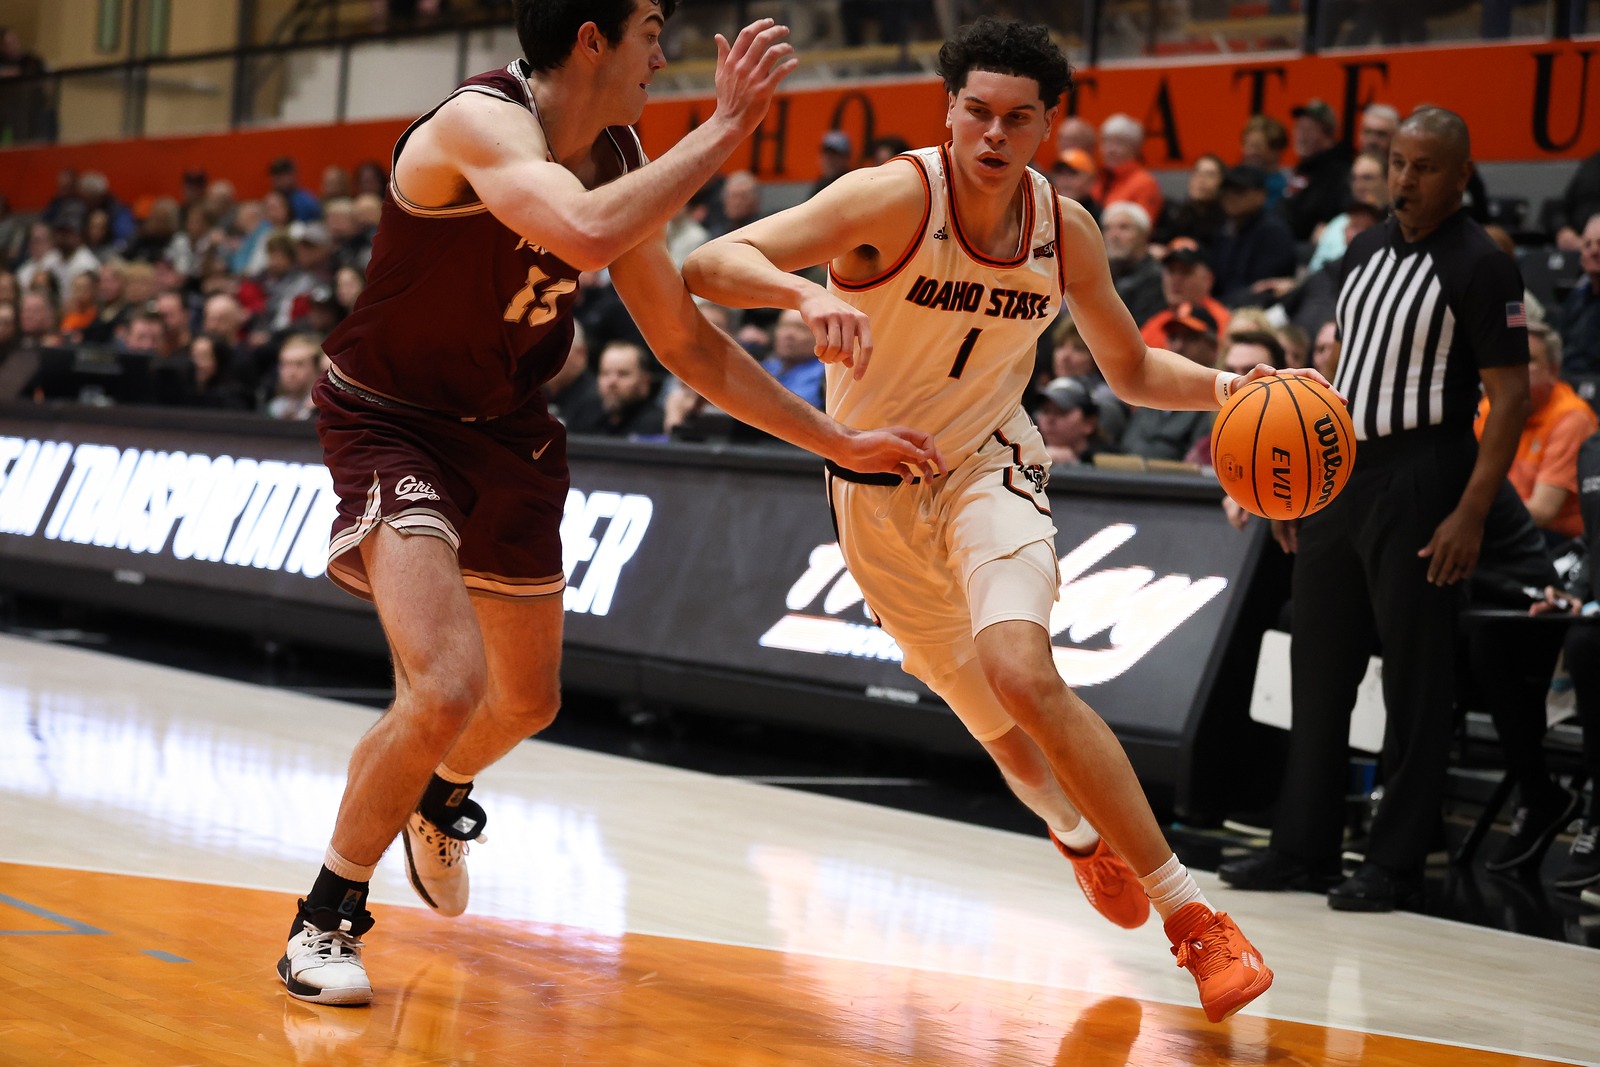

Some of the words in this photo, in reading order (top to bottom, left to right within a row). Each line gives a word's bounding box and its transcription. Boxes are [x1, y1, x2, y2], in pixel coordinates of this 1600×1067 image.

[1531, 48, 1600, 153] U
[905, 275, 985, 313] IDAHO
[984, 288, 1051, 320] STATE
[948, 327, 983, 379] 1
[1313, 413, 1343, 507] Wilson
